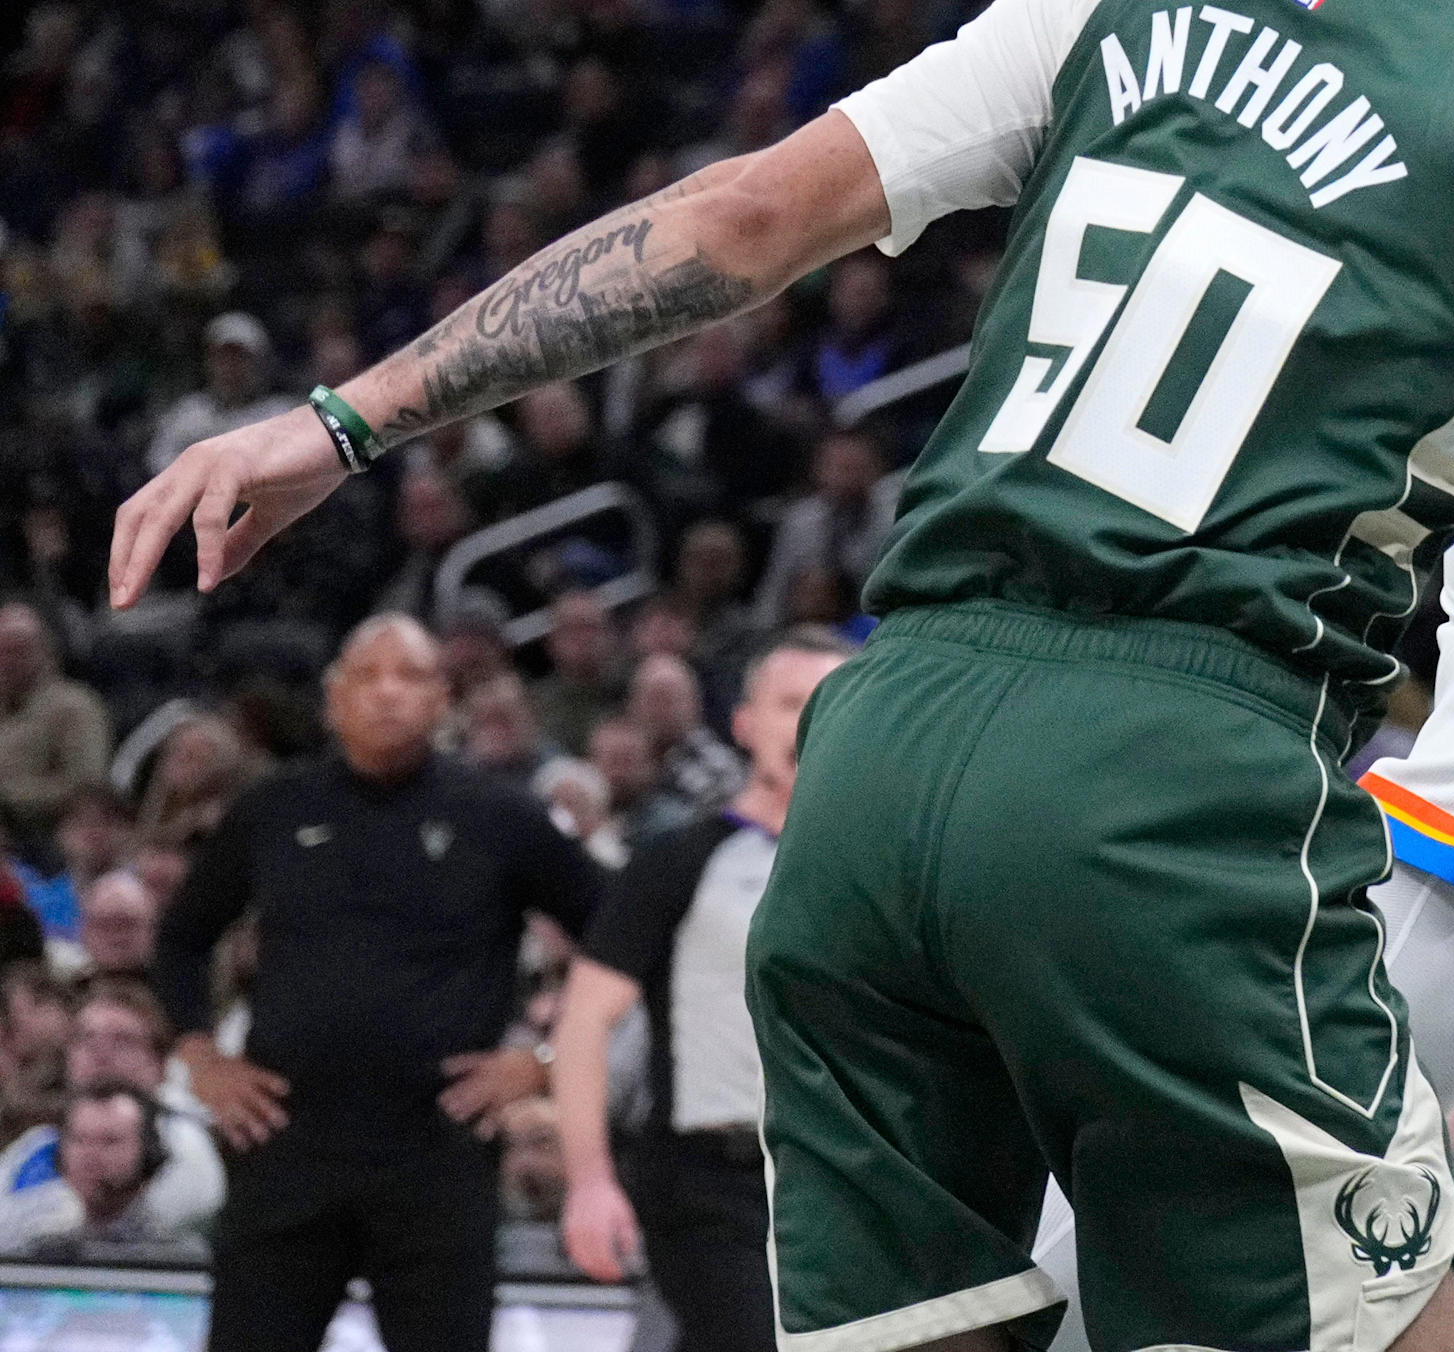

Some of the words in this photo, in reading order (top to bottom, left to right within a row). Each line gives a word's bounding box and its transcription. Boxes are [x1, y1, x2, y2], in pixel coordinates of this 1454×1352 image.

[1100, 4, 1409, 210] ANTHONY
[475, 218, 653, 339] Gregory
[977, 155, 1344, 535] 50
